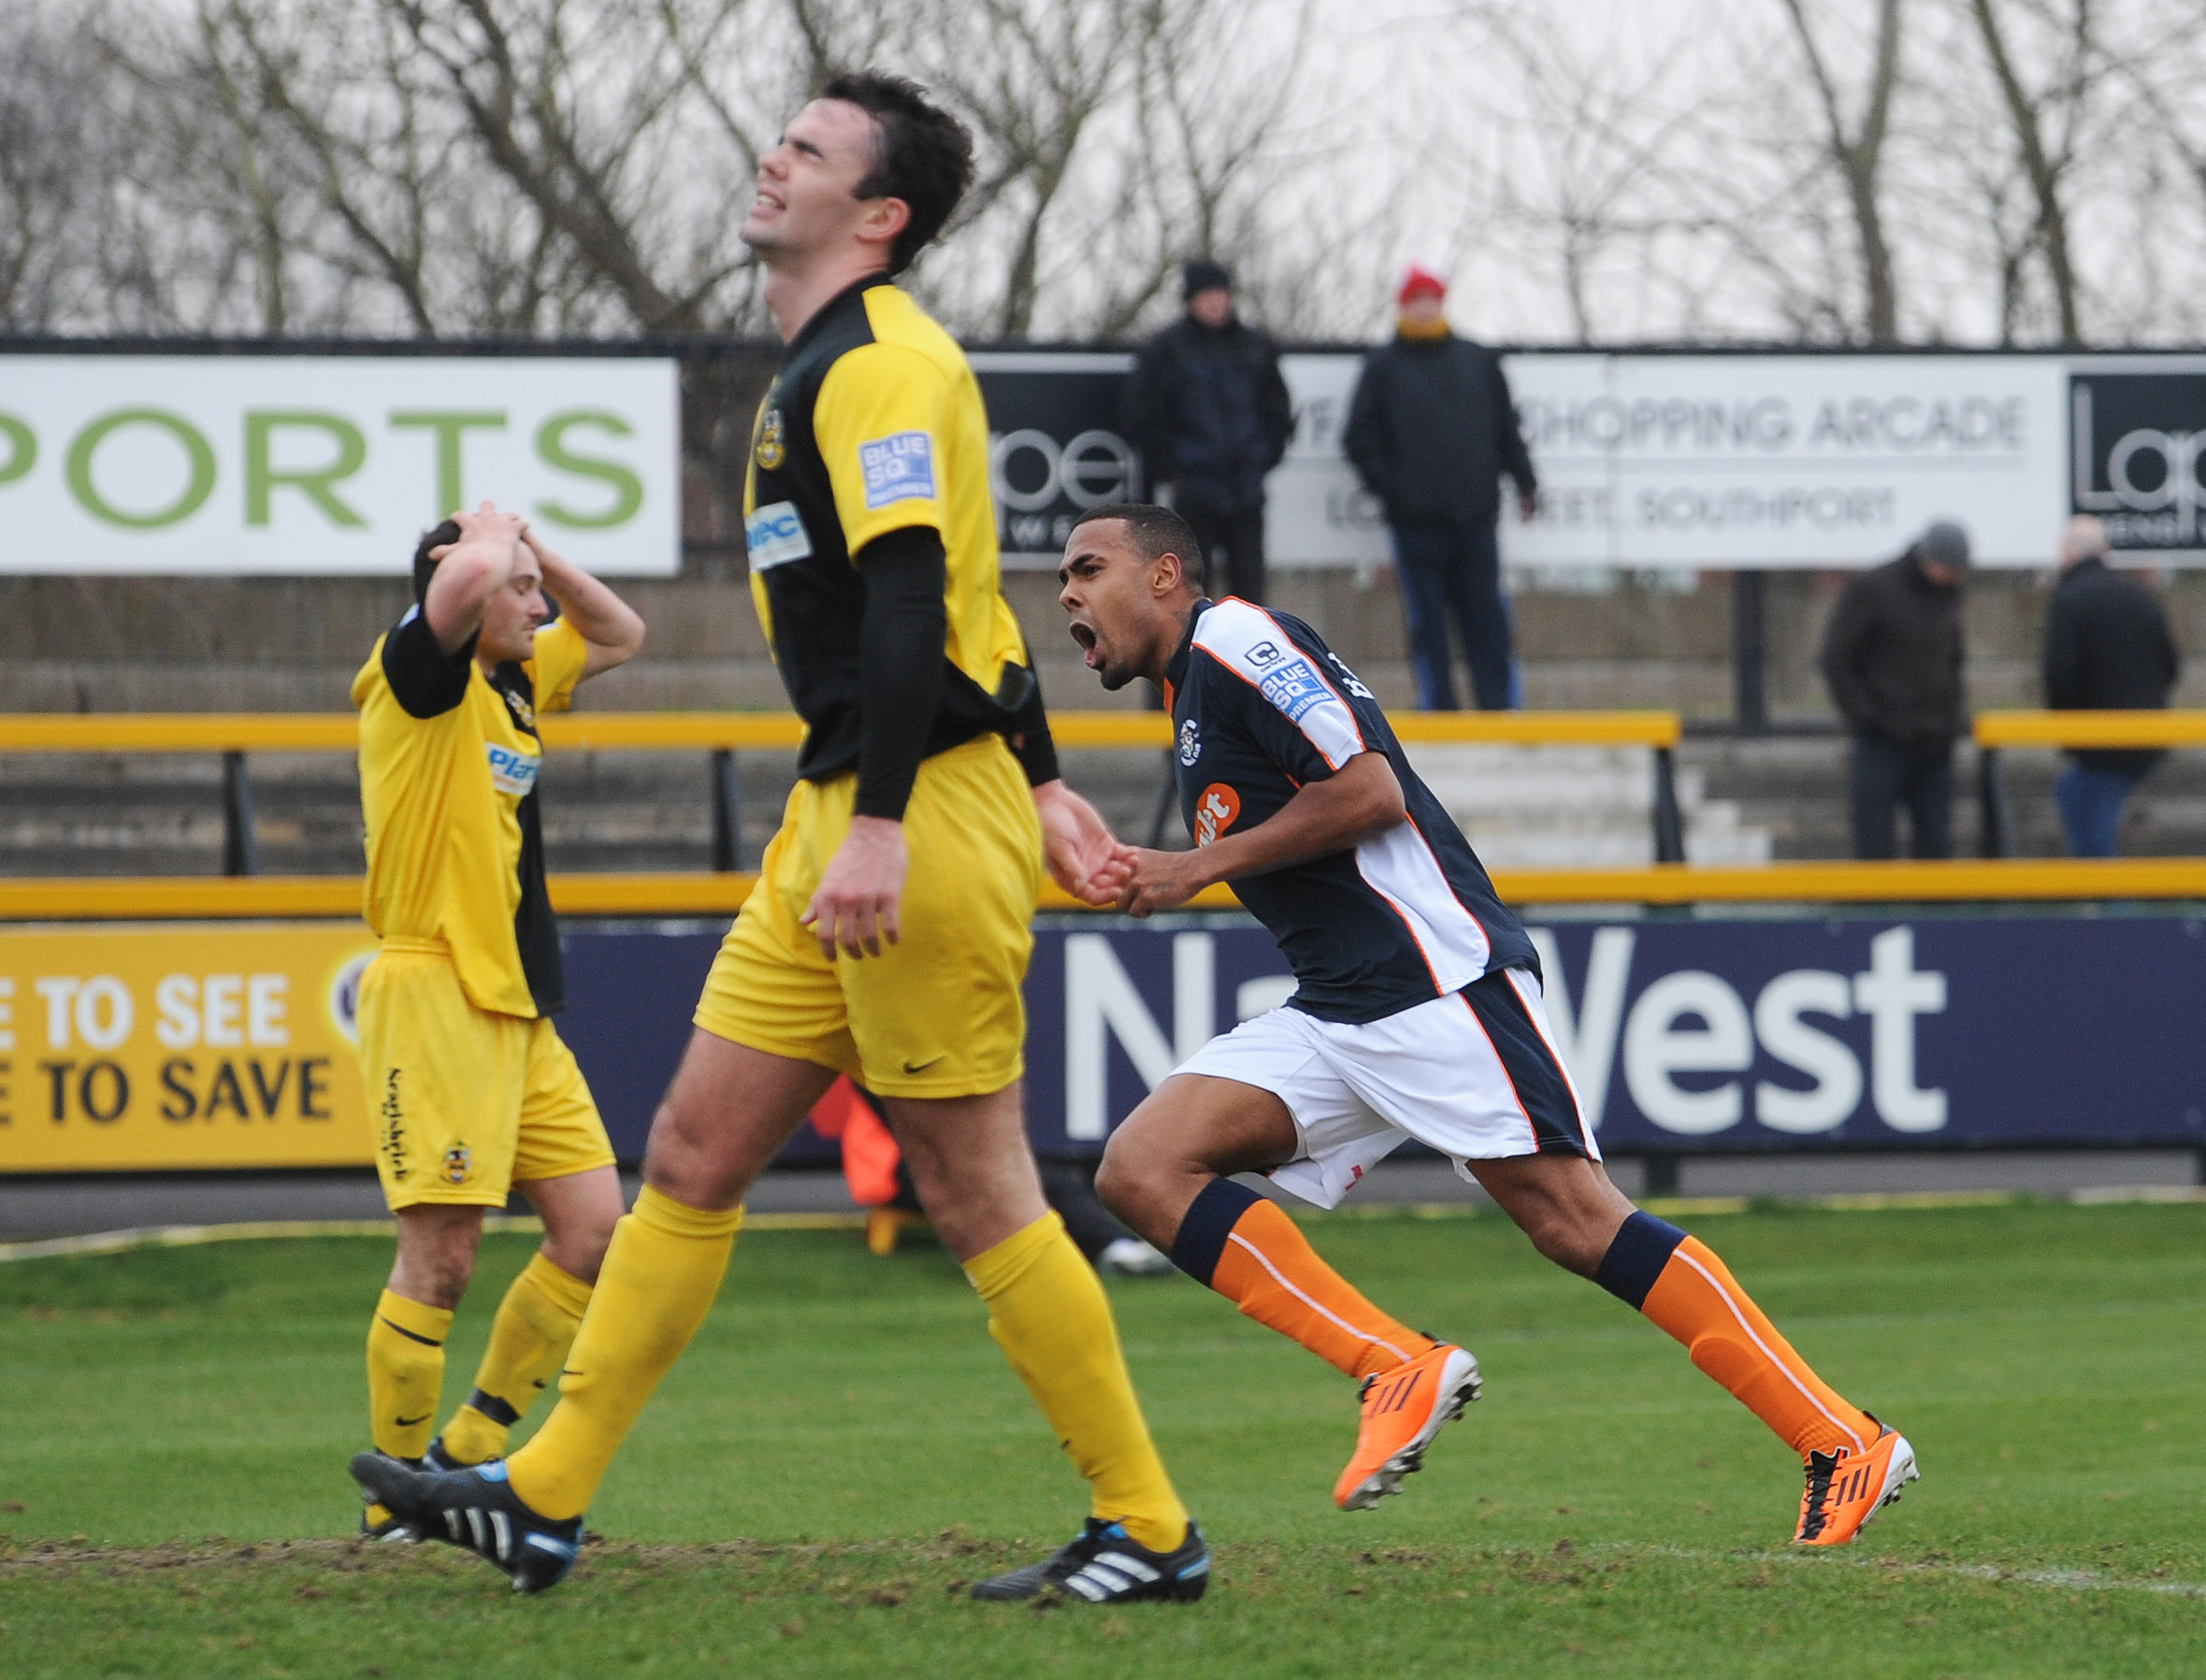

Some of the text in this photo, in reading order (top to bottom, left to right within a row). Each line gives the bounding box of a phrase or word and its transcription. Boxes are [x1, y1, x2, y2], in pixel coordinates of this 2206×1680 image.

[1809, 394, 2030, 452] ARCADE
[863, 435, 927, 467] BLUE
[864, 457, 911, 489] SQ
[1635, 484, 1896, 533] SOUTHPORT
[1262, 662, 1309, 698] BLUE
[1273, 679, 1308, 711] SQ
[1289, 691, 1333, 721] PREMIER
[35, 973, 134, 1051] TO
[155, 973, 289, 1048] SEE
[1064, 924, 1947, 1142] Nest
[39, 1056, 132, 1126] TO
[159, 1055, 332, 1124] SAVE
